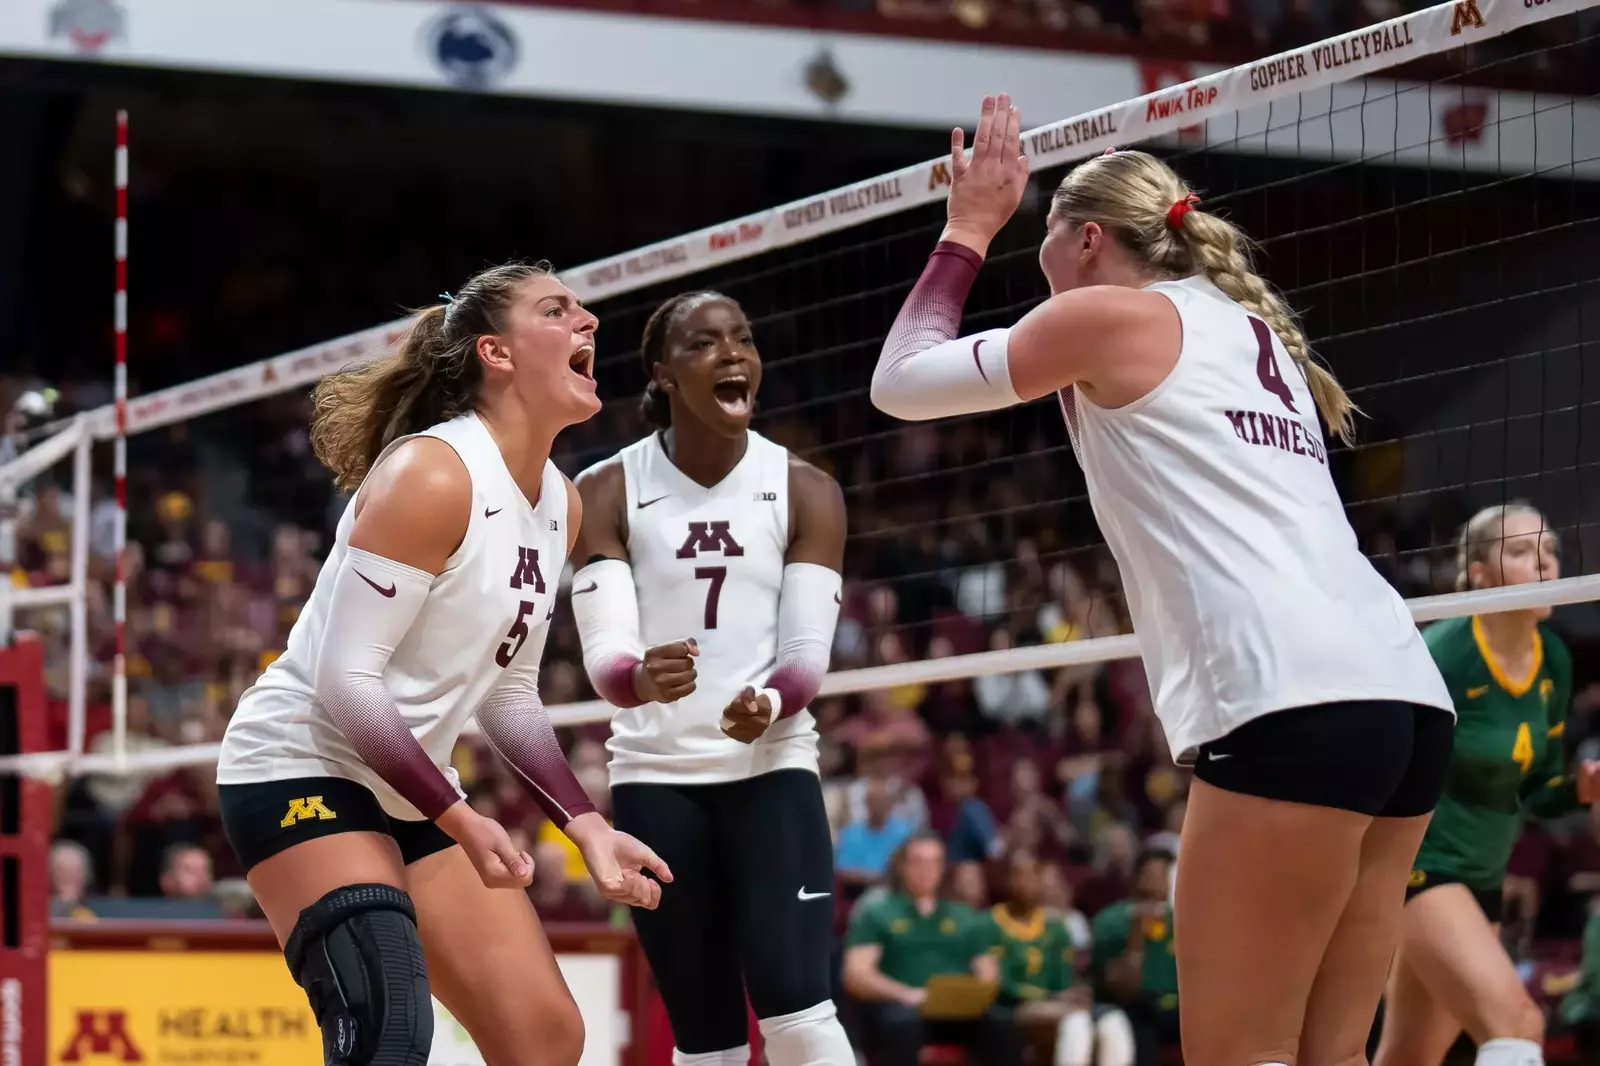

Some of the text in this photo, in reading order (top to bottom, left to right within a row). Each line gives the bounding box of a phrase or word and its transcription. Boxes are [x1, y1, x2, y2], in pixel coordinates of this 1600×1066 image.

[1250, 21, 1414, 92] GOPHER VOLLEYBALL
[1031, 112, 1117, 156] VOLLEYBALL
[1246, 314, 1302, 416] 4
[676, 520, 744, 559] M
[510, 545, 546, 594] M
[695, 566, 727, 630] 7
[495, 600, 534, 669] 5
[1512, 721, 1535, 774] 4
[280, 795, 337, 828] M
[59, 1009, 145, 1063] M
[157, 1006, 310, 1039] HEALTH
